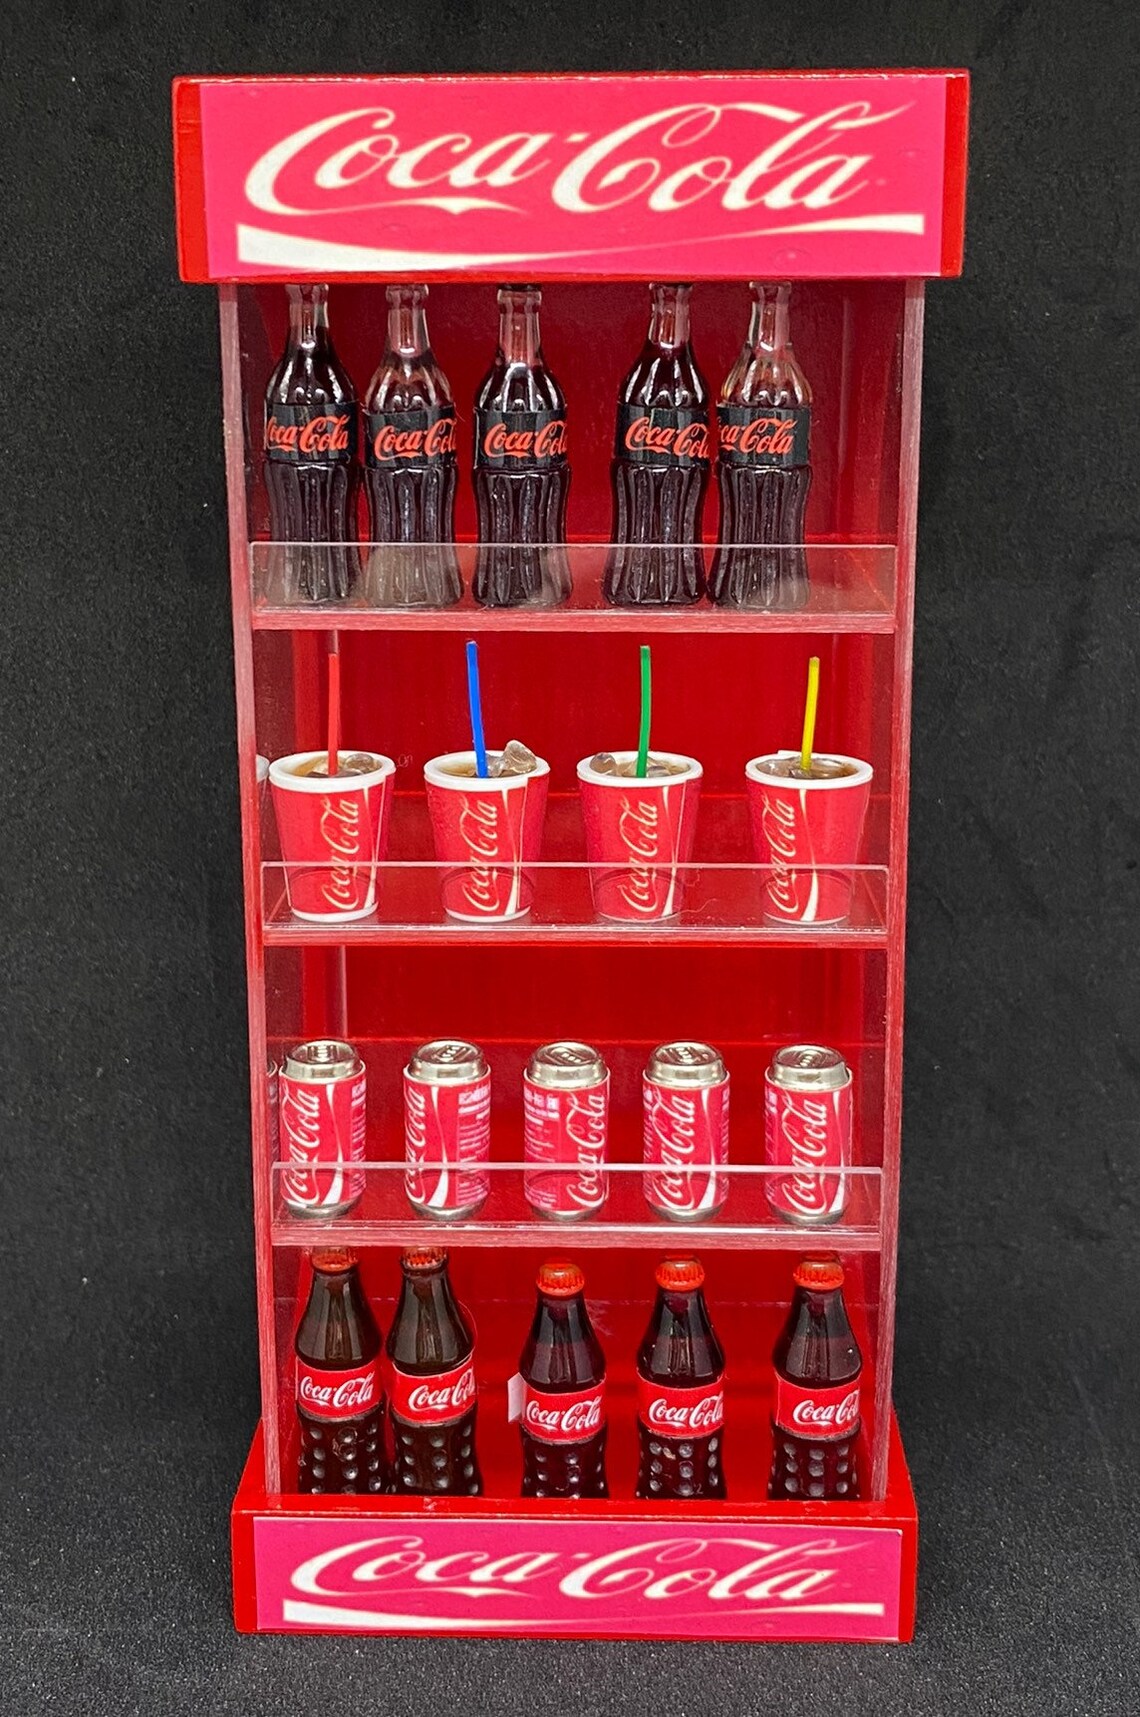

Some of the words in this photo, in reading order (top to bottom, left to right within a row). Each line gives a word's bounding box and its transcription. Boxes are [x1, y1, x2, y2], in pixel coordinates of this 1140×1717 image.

[243, 100, 915, 214] Coca-Cola
[718, 417, 798, 454] ca-Cola
[320, 794, 360, 911] Coca-Cola
[459, 794, 500, 912] Coca-Cola
[617, 794, 659, 913] Coca-Cola
[762, 788, 800, 914] Coca-Cola
[566, 1091, 606, 1208] Coca-Cola
[652, 1085, 696, 1210] Coca-Cola
[781, 1090, 828, 1214] Coca-Cola
[300, 1371, 375, 1408] Coca-Cola
[526, 1395, 603, 1432] Coca-Cola
[793, 1389, 860, 1427] Coca-Col
[290, 1535, 876, 1601] Coca-Cola
